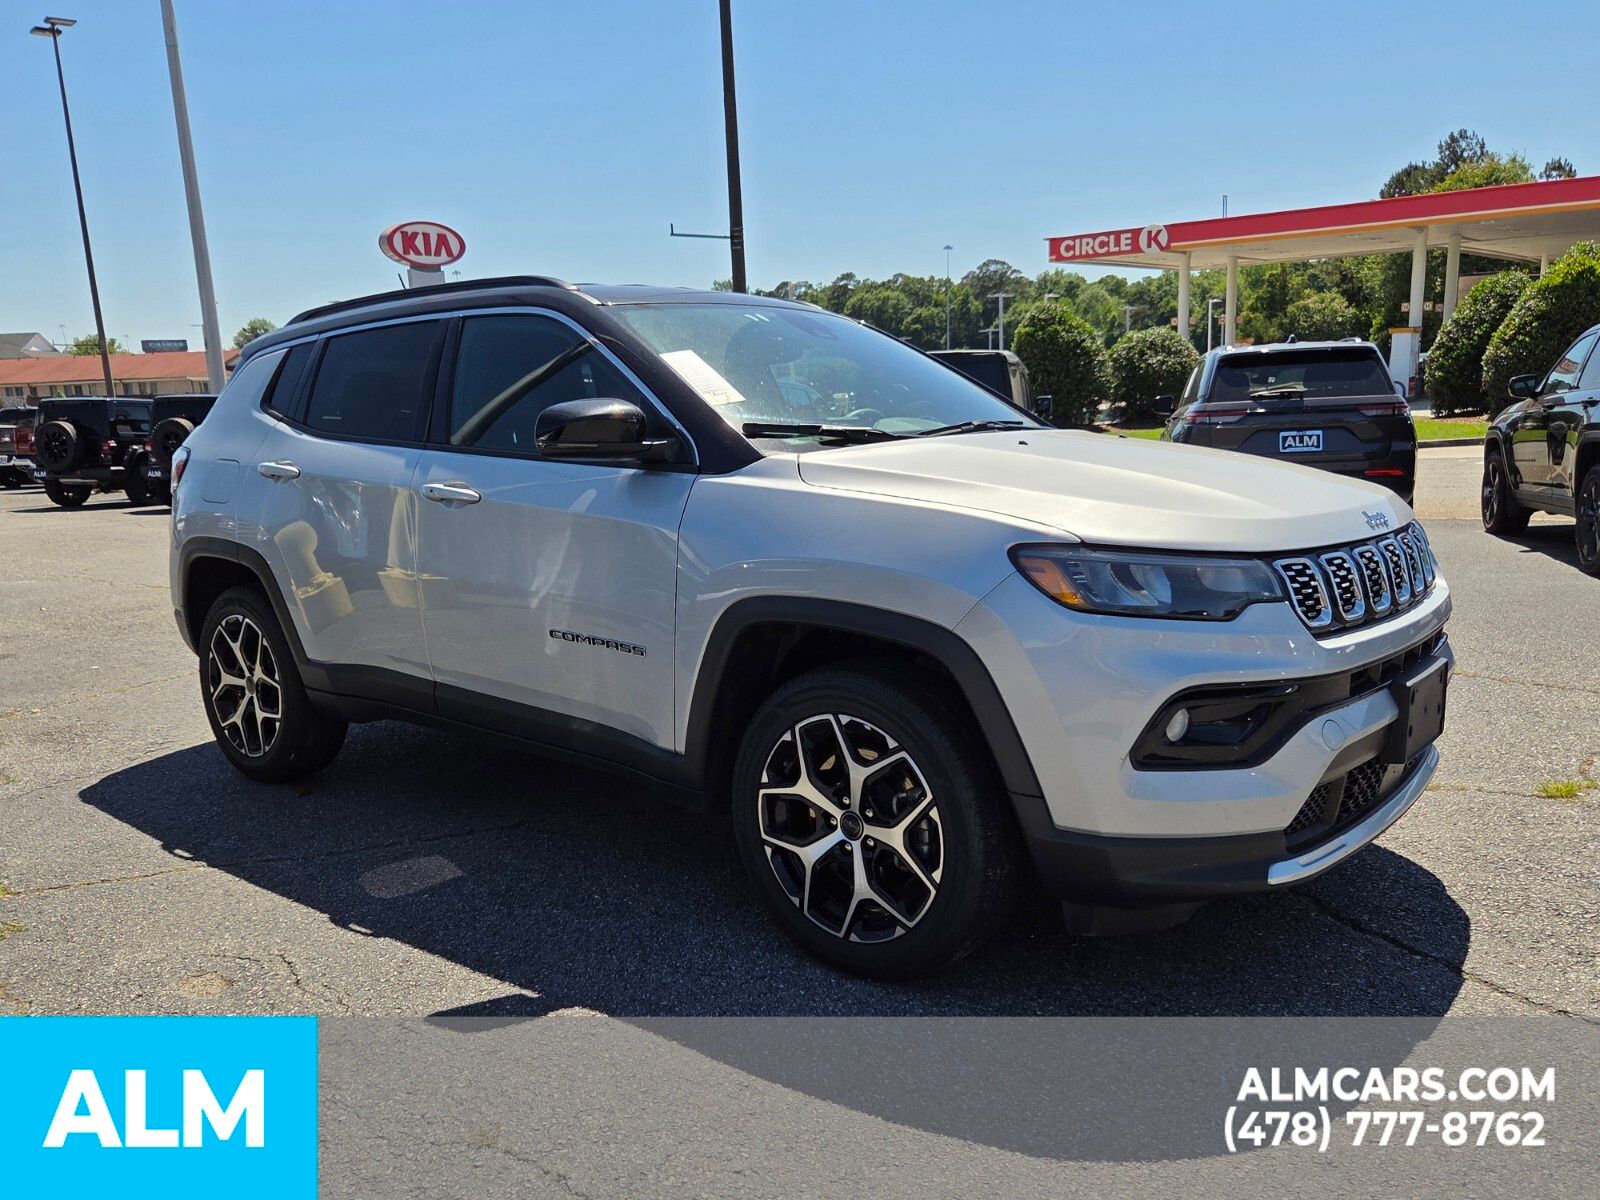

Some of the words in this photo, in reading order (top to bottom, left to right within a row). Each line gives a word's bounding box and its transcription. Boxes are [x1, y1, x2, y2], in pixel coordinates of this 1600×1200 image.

[399, 230, 455, 258] KIA
[1059, 233, 1132, 257] CIRCLE
[1146, 229, 1165, 251] K
[1284, 435, 1318, 447] ALM
[549, 629, 647, 657] COMPASS
